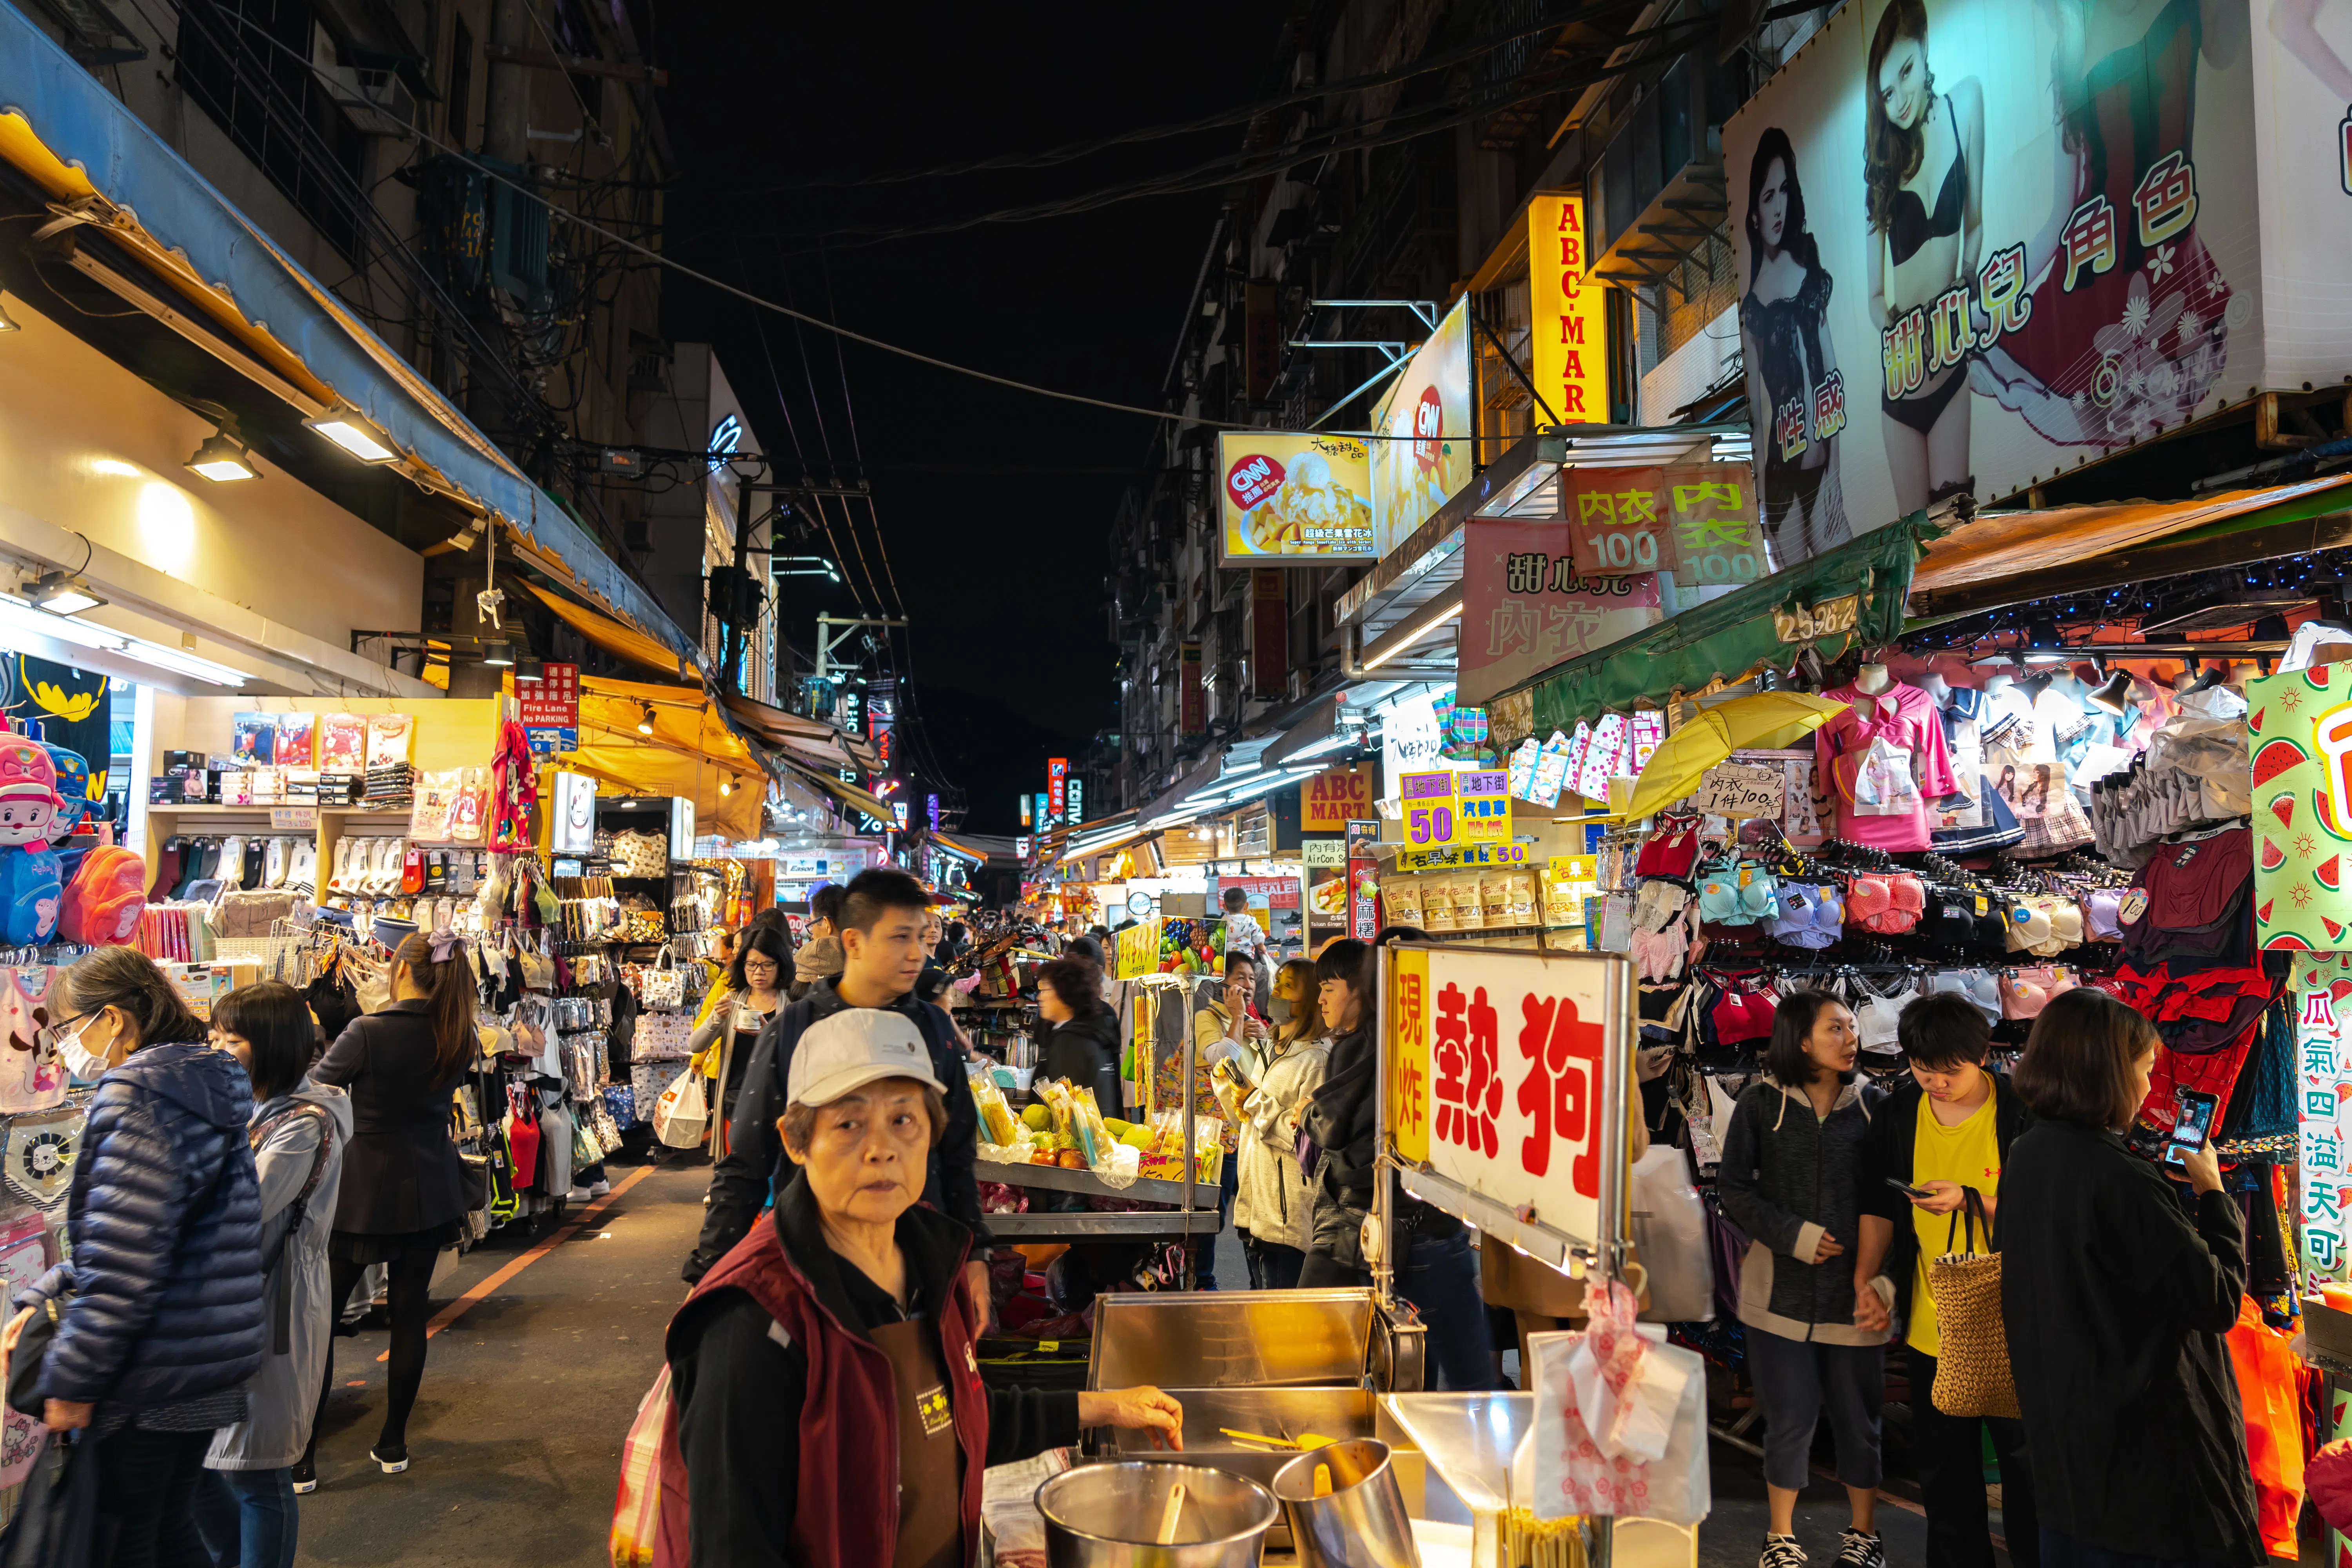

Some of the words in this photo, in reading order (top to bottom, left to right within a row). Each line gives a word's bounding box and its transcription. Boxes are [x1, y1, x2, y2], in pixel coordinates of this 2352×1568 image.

[2060, 151, 2199, 293] 角色
[1882, 243, 2034, 401] 甜心兒
[1418, 401, 1440, 438] CNN
[1776, 368, 1846, 463] 性感
[1231, 457, 1271, 492] CNN
[1241, 485, 1263, 504] 推薦
[1305, 528, 1373, 539] 超級芒果雪花冰
[1588, 531, 1659, 568] 100
[1683, 553, 1759, 581] 100
[548, 667, 572, 677] 通道
[521, 691, 572, 701] 加強拖吊
[544, 704, 567, 713] Lane
[535, 715, 569, 723] PARKING
[1310, 775, 1365, 800] ABC
[1415, 777, 1448, 794] 地下街
[1462, 775, 1470, 794] 百貨
[1471, 775, 1504, 791] 地下街
[1068, 779, 1082, 825] CONV
[1463, 800, 1506, 818] 汽機車
[1310, 803, 1365, 820] MART
[1410, 806, 1452, 844] 50
[1468, 820, 1504, 838] 貼紙
[1308, 854, 1334, 863] AirCon
[1497, 846, 1523, 862] 50
[1557, 861, 1593, 879] 古早味
[1259, 883, 1299, 896] SALE!!
[2123, 898, 2143, 916] 100
[1399, 972, 1422, 1137] 現炸
[1434, 981, 1604, 1199] 熱狗
[1140, 1156, 1167, 1168] 大特價
